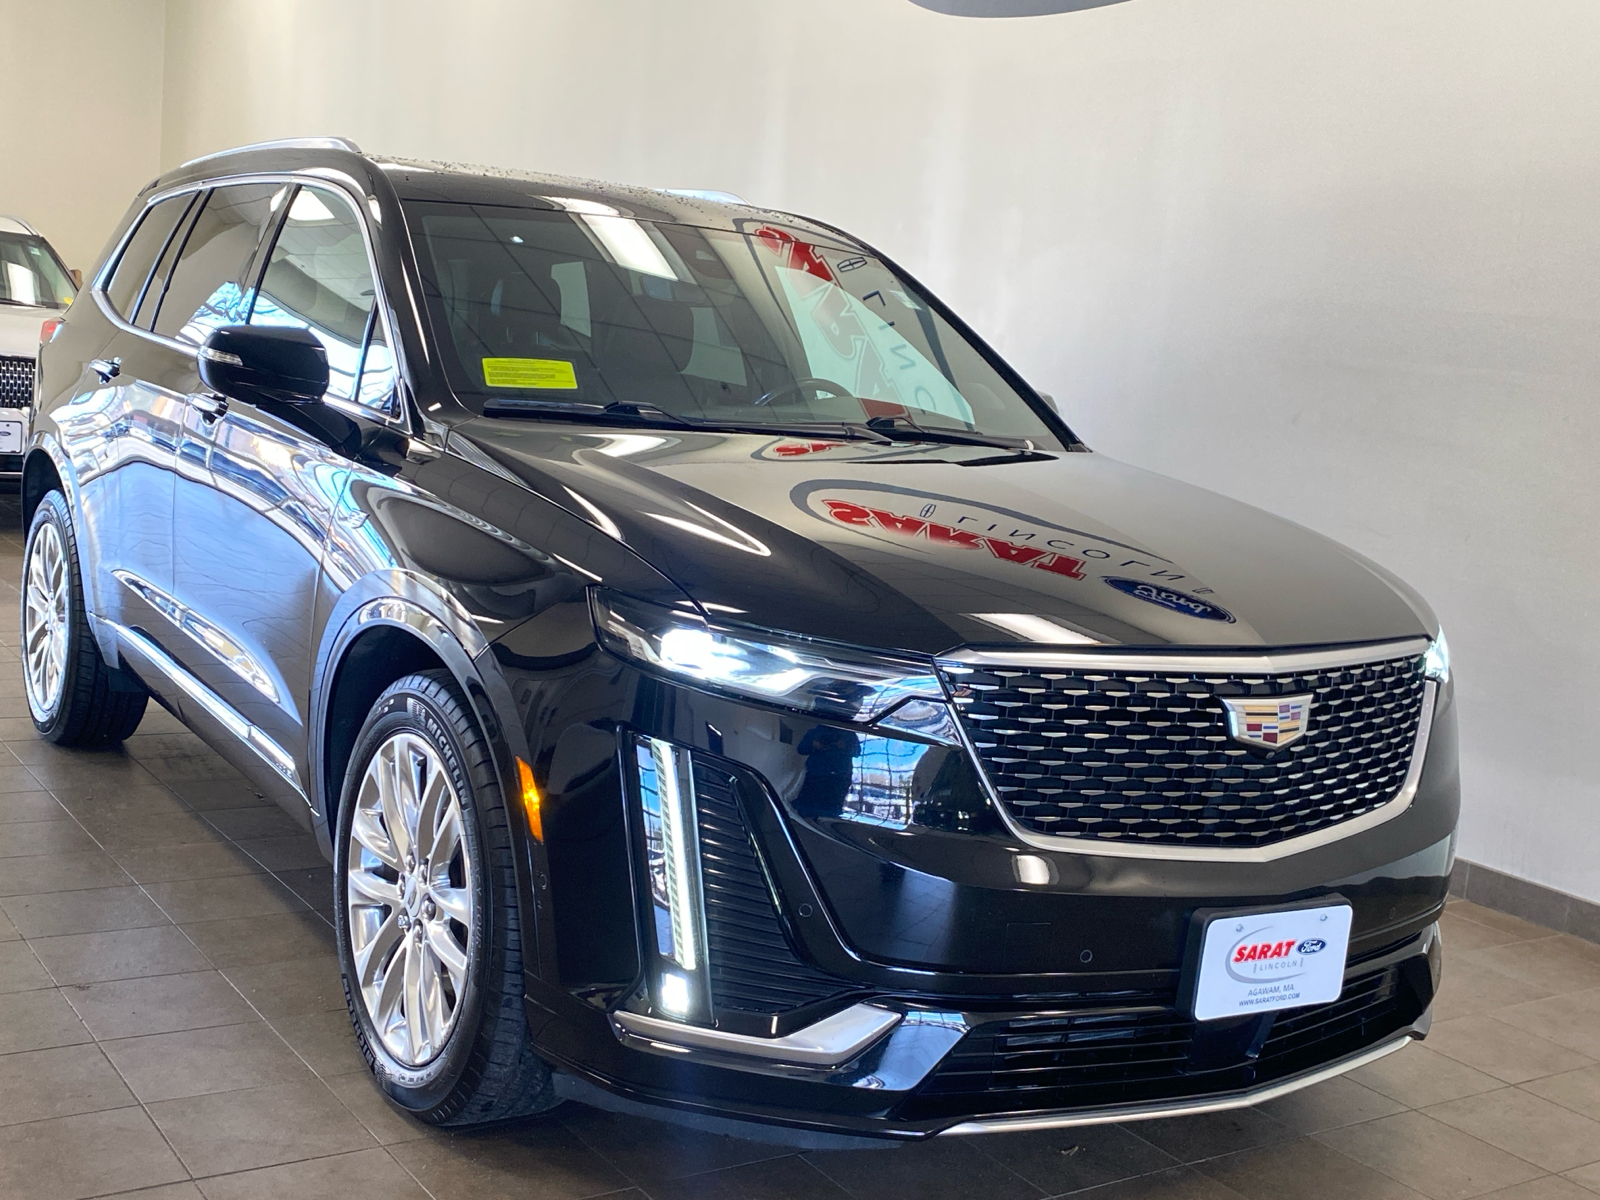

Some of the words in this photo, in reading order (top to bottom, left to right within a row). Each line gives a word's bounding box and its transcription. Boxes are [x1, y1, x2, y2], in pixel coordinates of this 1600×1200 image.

[427, 718, 468, 805] MICHELIN
[1233, 939, 1297, 963] SARAT
[1259, 960, 1298, 971] LINCOLN
[1247, 985, 1281, 997] AGAWAM,
[1283, 983, 1295, 991] MA
[1239, 992, 1300, 1006] WWW.SARATFORD.COM
